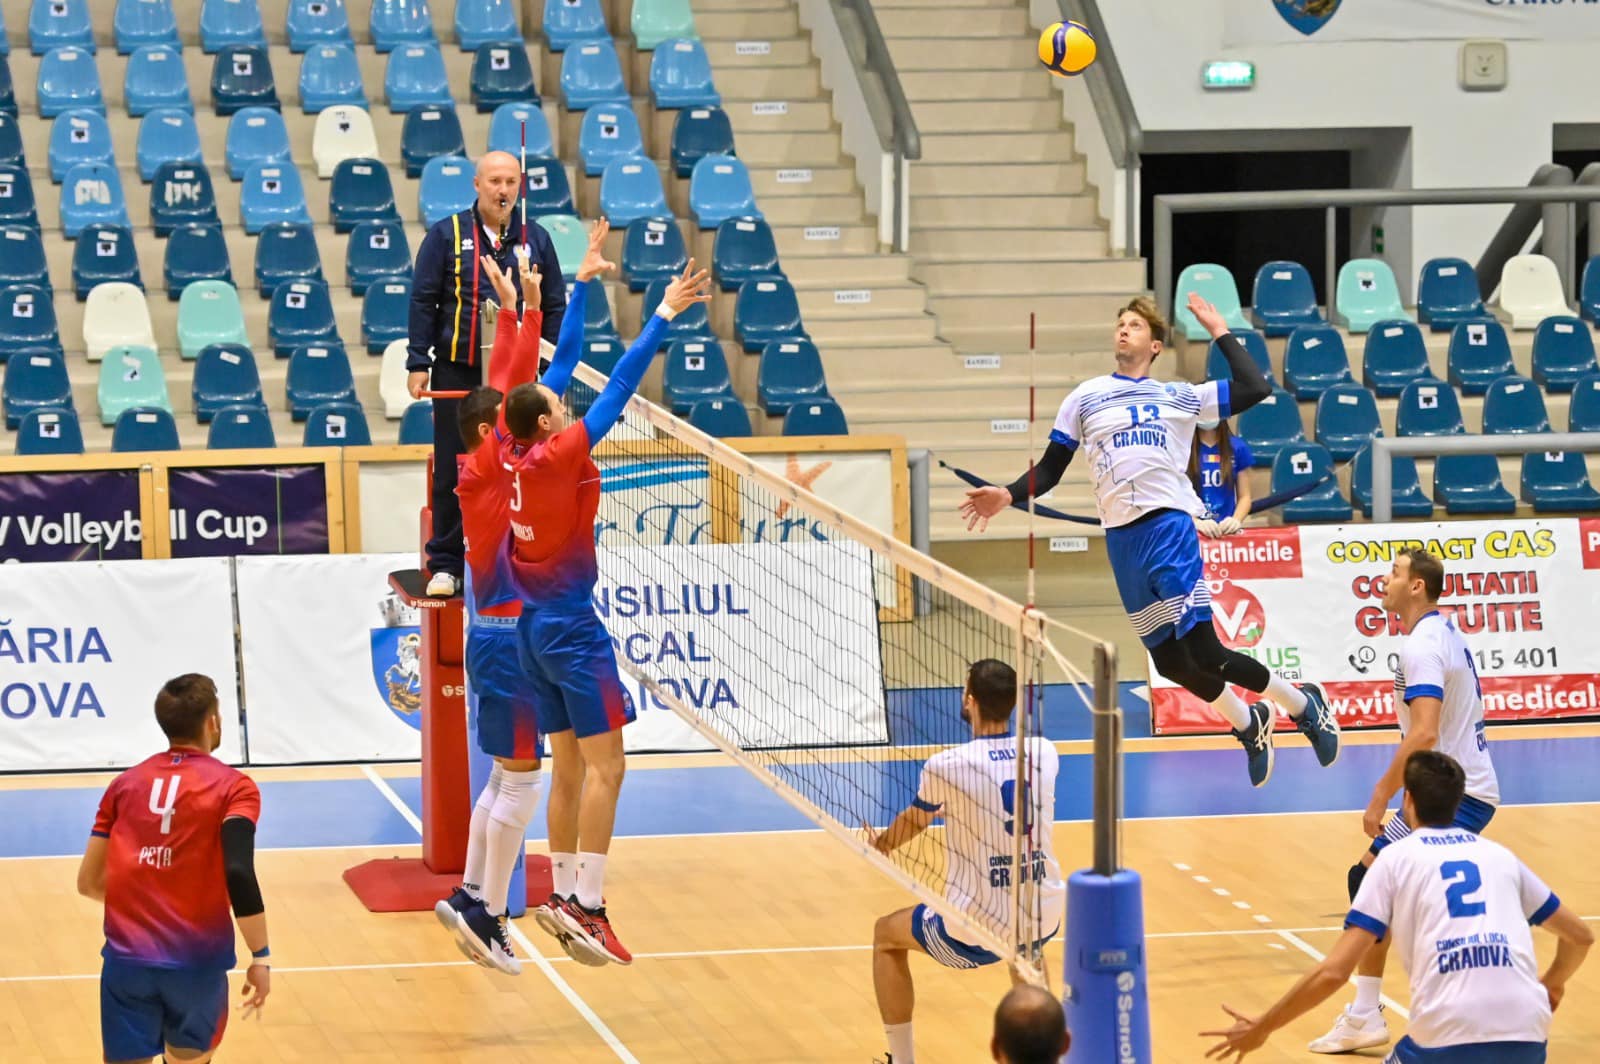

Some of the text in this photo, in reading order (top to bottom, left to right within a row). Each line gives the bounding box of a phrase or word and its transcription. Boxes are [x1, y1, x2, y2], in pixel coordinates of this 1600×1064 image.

[1126, 404, 1160, 427] 13
[1113, 430, 1167, 449] CRAIOVA
[1202, 469, 1223, 488] 10
[18, 509, 187, 550] Volleybll
[196, 509, 268, 545] Cup
[1484, 530, 1556, 559] CAS
[1352, 571, 1539, 599] COULTATII
[1355, 601, 1543, 638] GRUITE
[1513, 646, 1558, 668] 401
[0, 682, 106, 719] OVA
[149, 774, 181, 834] 4
[1440, 859, 1487, 918] 2
[1438, 945, 1513, 974] CRAIOVA
